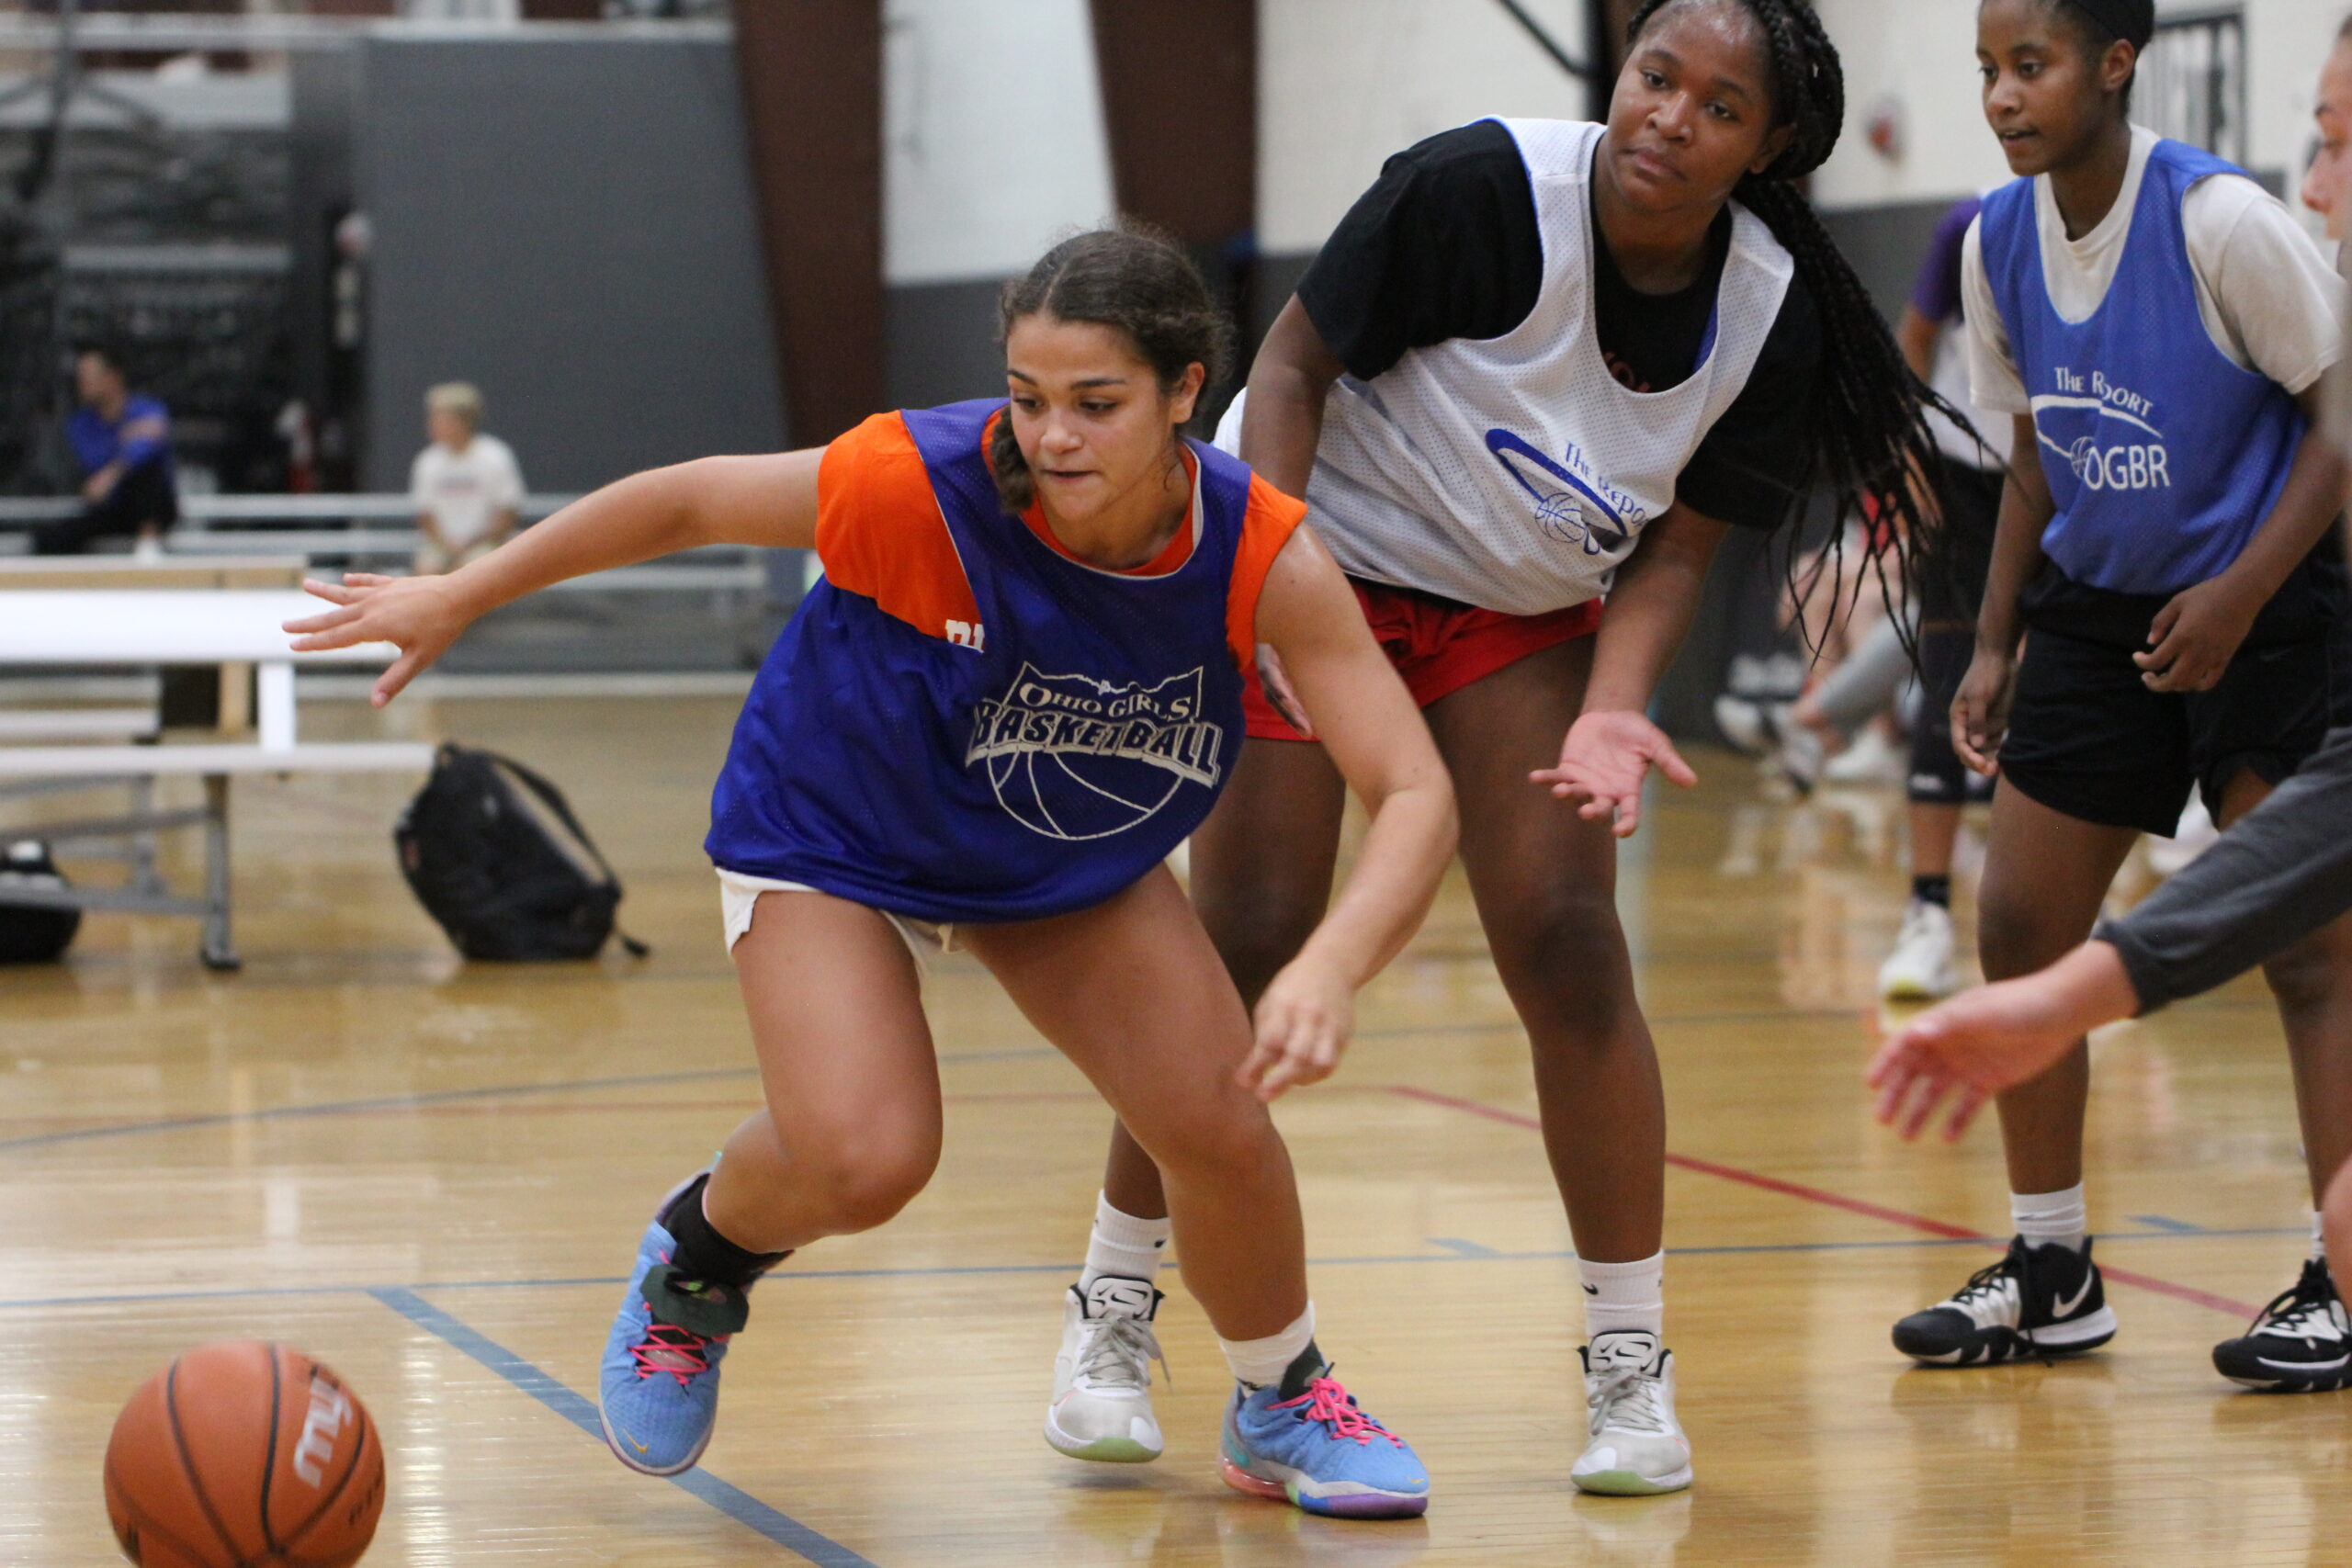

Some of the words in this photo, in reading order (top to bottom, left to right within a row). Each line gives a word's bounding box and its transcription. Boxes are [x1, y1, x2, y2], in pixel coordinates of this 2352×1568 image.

[2084, 444, 2171, 491] OGBR
[1019, 682, 1102, 715] OHIO
[1108, 693, 1193, 722] GIRLS
[966, 697, 1223, 788] BASKETBALL
